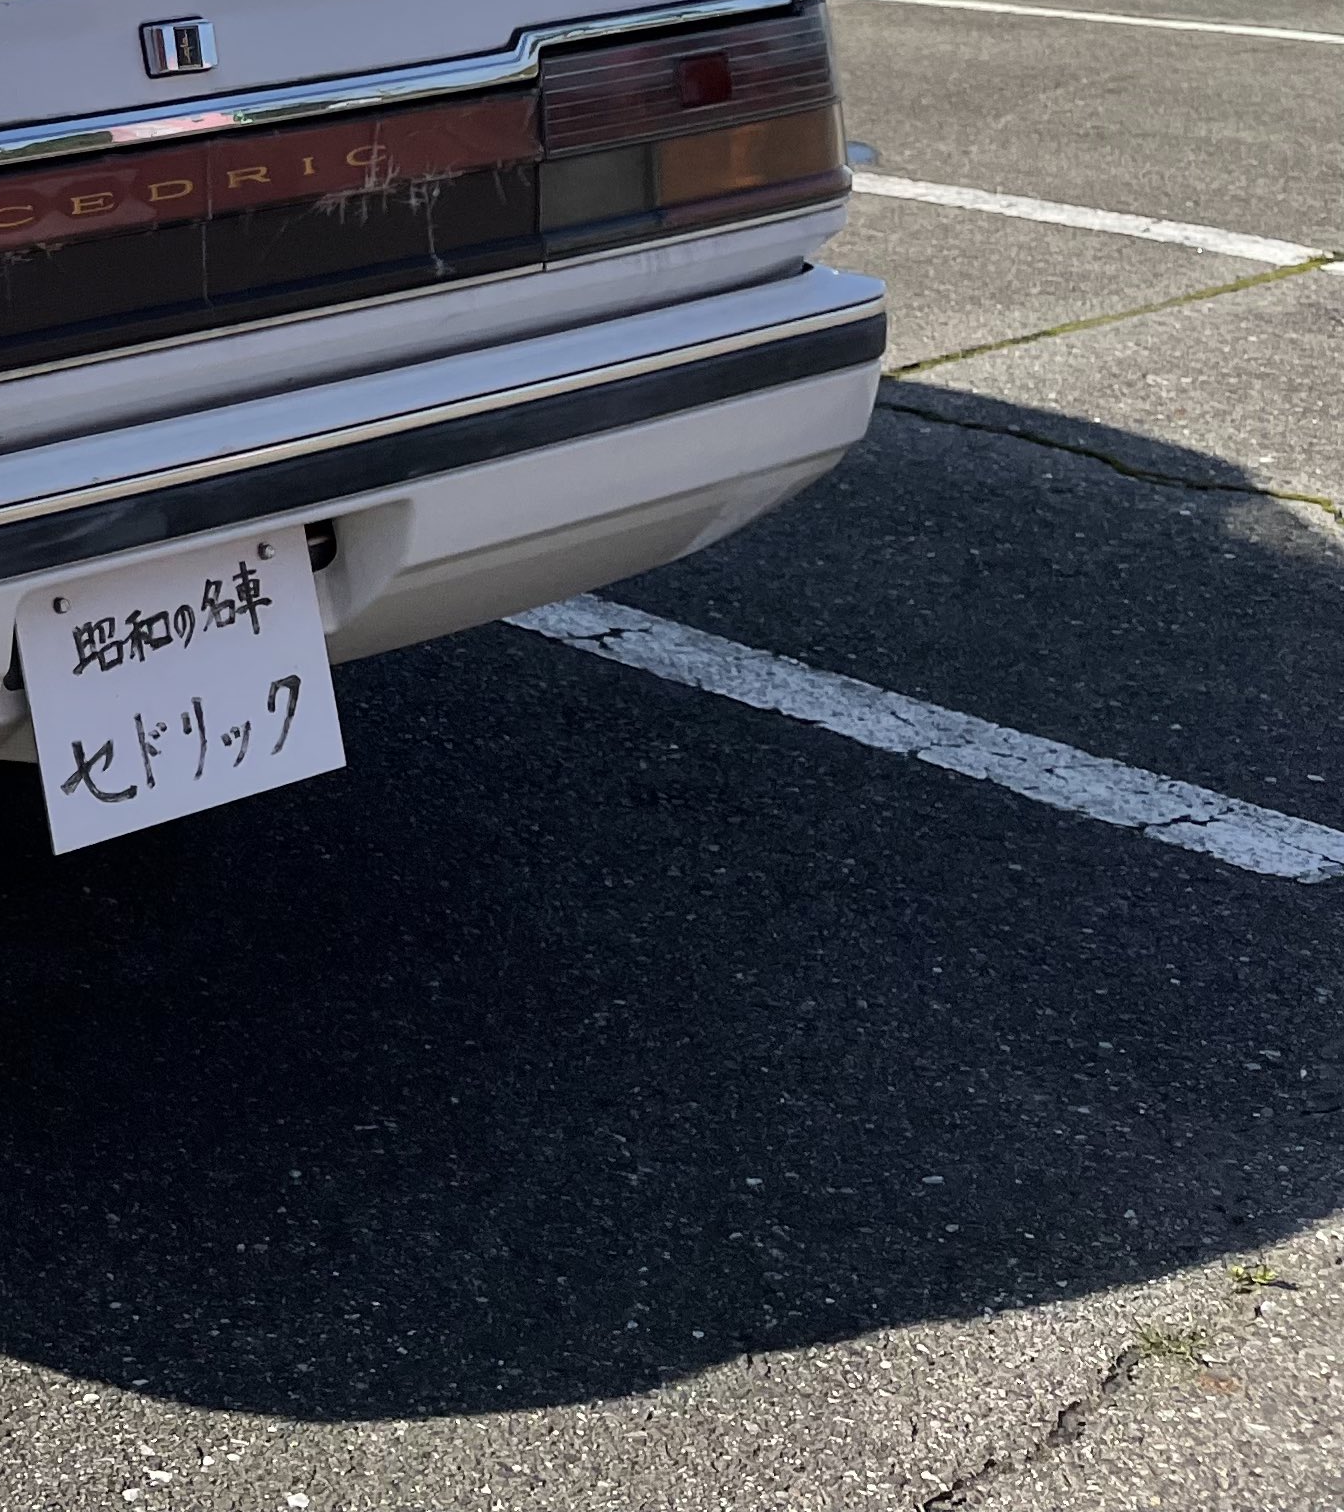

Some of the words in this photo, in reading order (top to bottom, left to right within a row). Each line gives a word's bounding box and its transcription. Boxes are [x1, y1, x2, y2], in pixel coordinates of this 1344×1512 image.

[73, 561, 272, 675] 昭和の名車
[61, 675, 301, 803] セドリック
